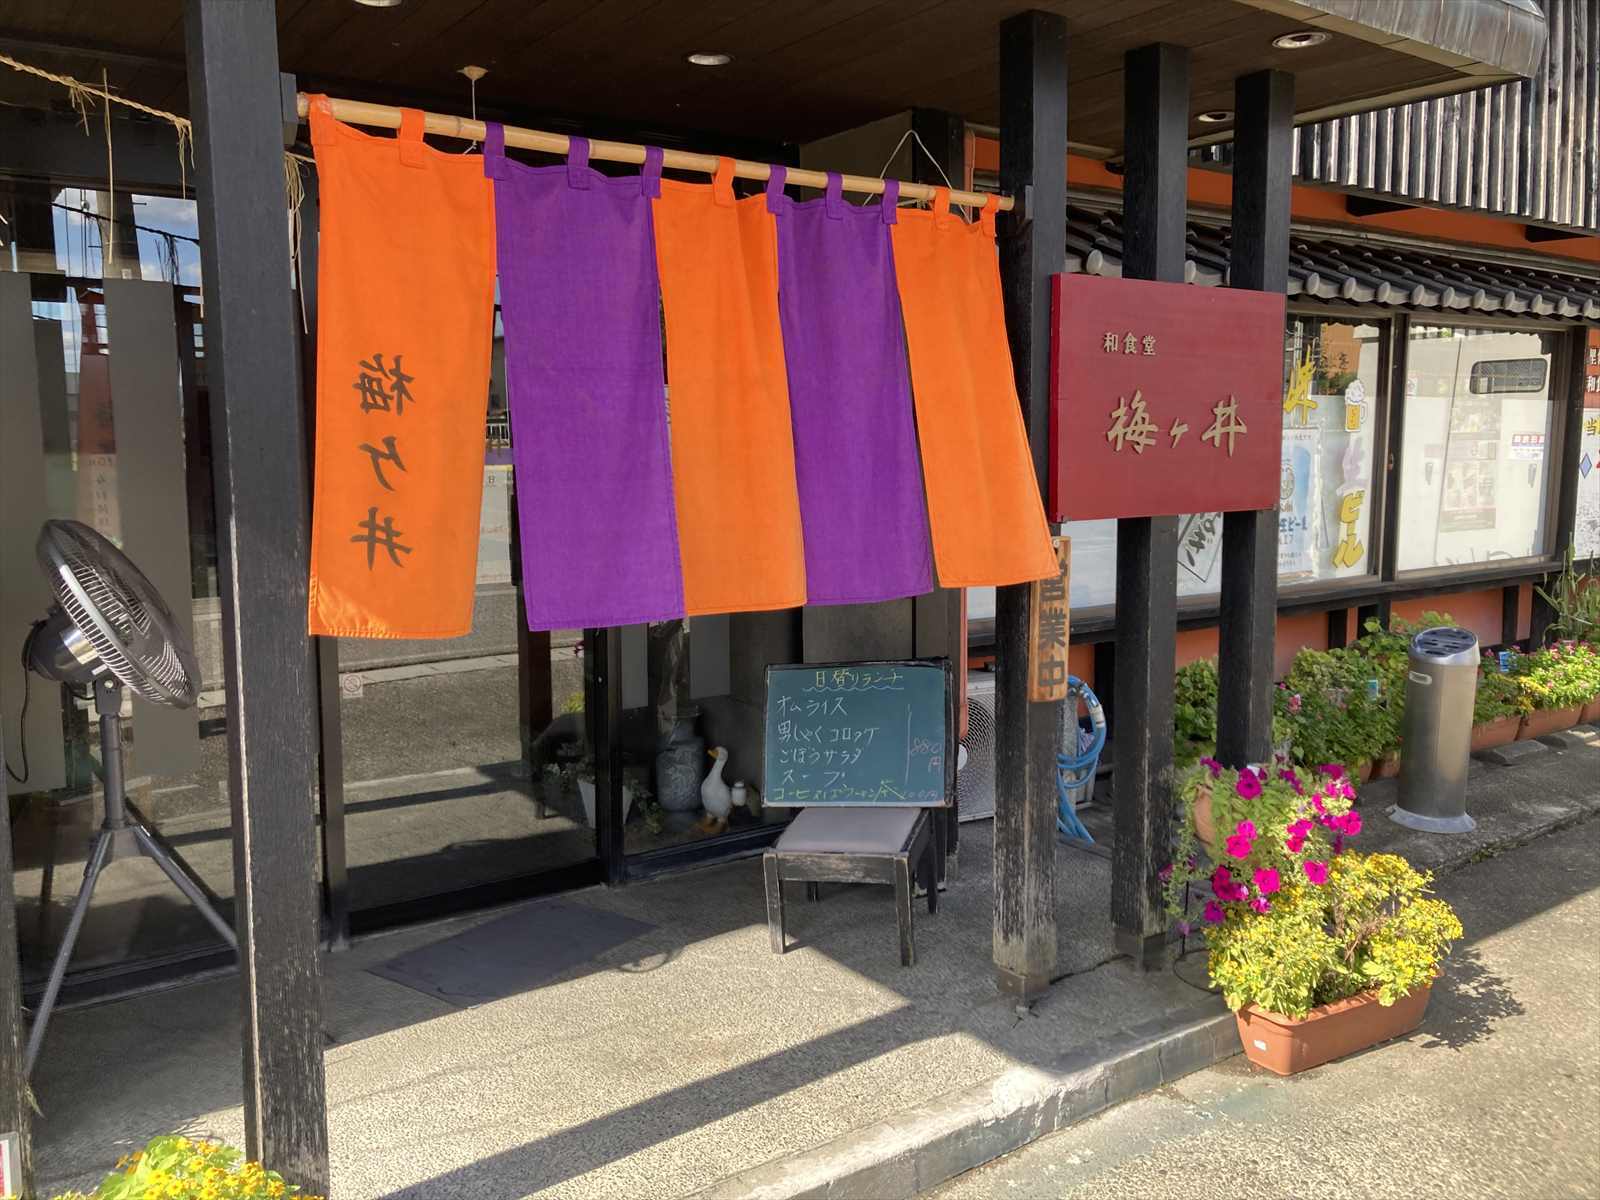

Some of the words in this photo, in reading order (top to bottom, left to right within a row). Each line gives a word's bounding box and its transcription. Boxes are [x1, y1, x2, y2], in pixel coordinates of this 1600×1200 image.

[1103, 331, 1157, 356] 和食堂
[777, 695, 848, 717] オムライス
[782, 769, 846, 788] スープ
